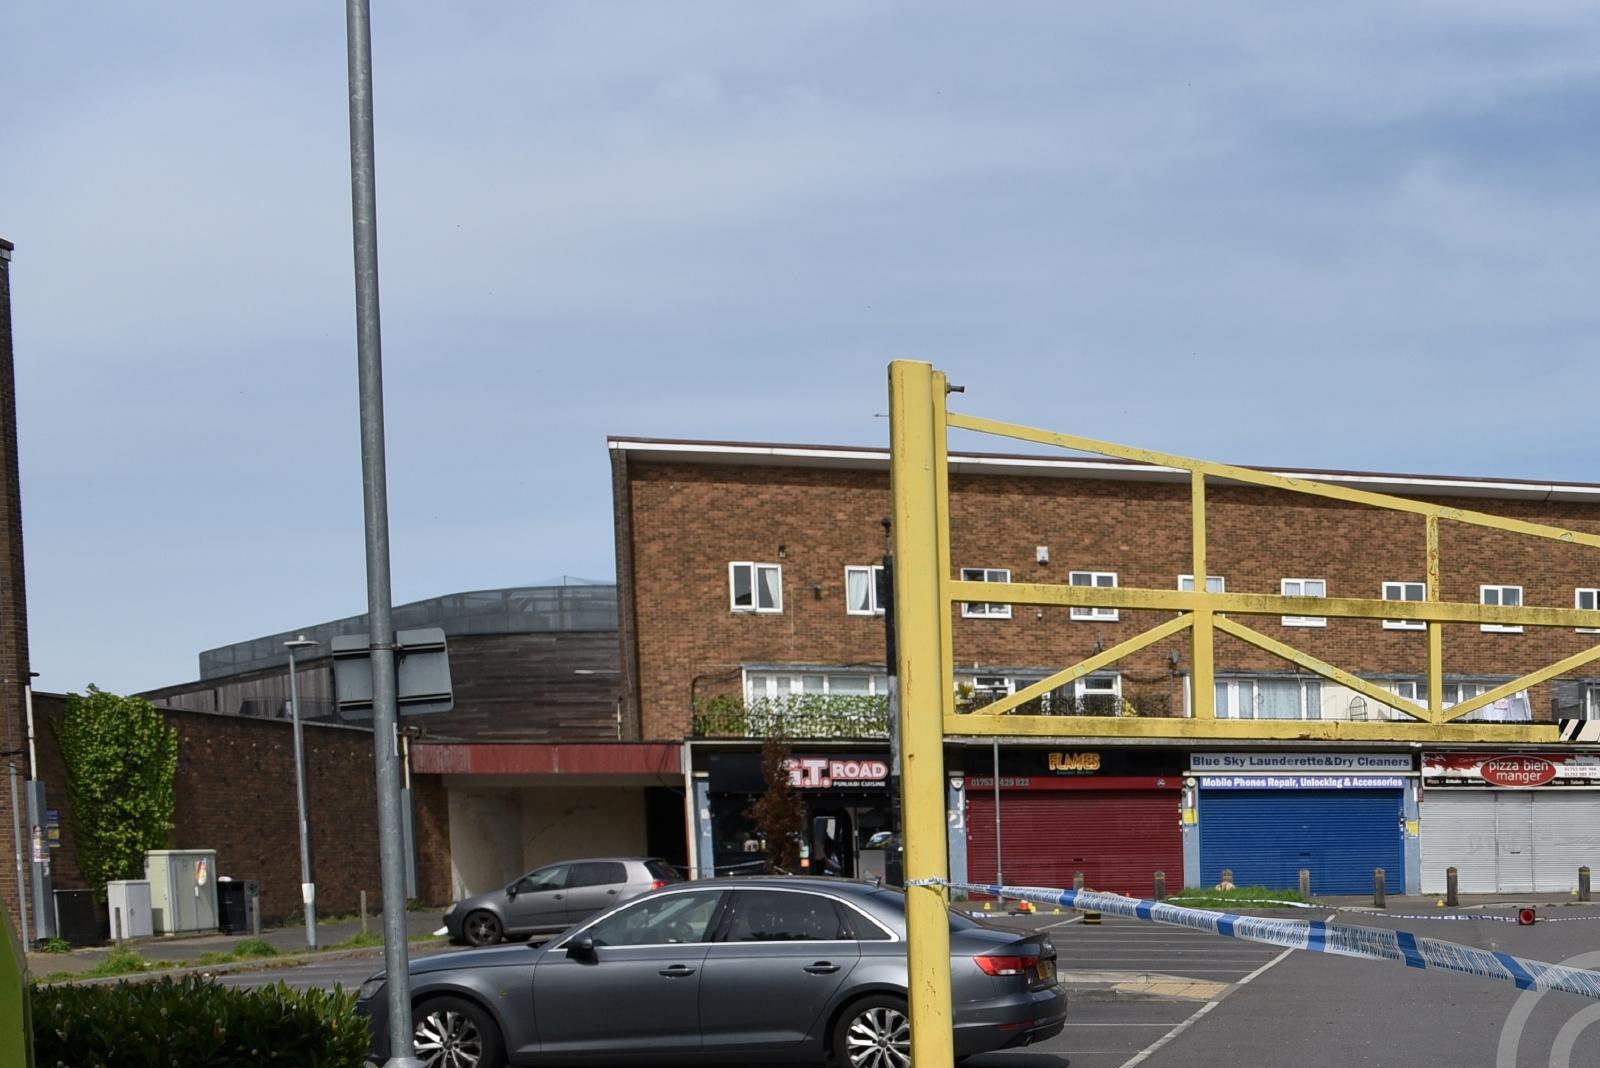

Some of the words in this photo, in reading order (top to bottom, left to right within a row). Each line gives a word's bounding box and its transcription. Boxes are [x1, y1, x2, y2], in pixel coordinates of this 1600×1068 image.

[1048, 752, 1101, 770] FLAMES
[1192, 756, 1220, 766] Blue
[1223, 756, 1246, 768] Sky
[1250, 756, 1354, 768] Launderette&Dry
[1357, 757, 1410, 767] Cleaners
[1488, 760, 1520, 773] pizza
[1523, 759, 1549, 771] bien
[831, 760, 888, 779] ROAD
[1202, 778, 1233, 787] Mobile
[1234, 778, 1266, 787] Phones
[1267, 778, 1299, 789] Repair,
[1300, 778, 1343, 788] Unlocking
[1344, 778, 1351, 787] &
[1352, 777, 1403, 786] Accessories
[1495, 771, 1543, 782] manger
